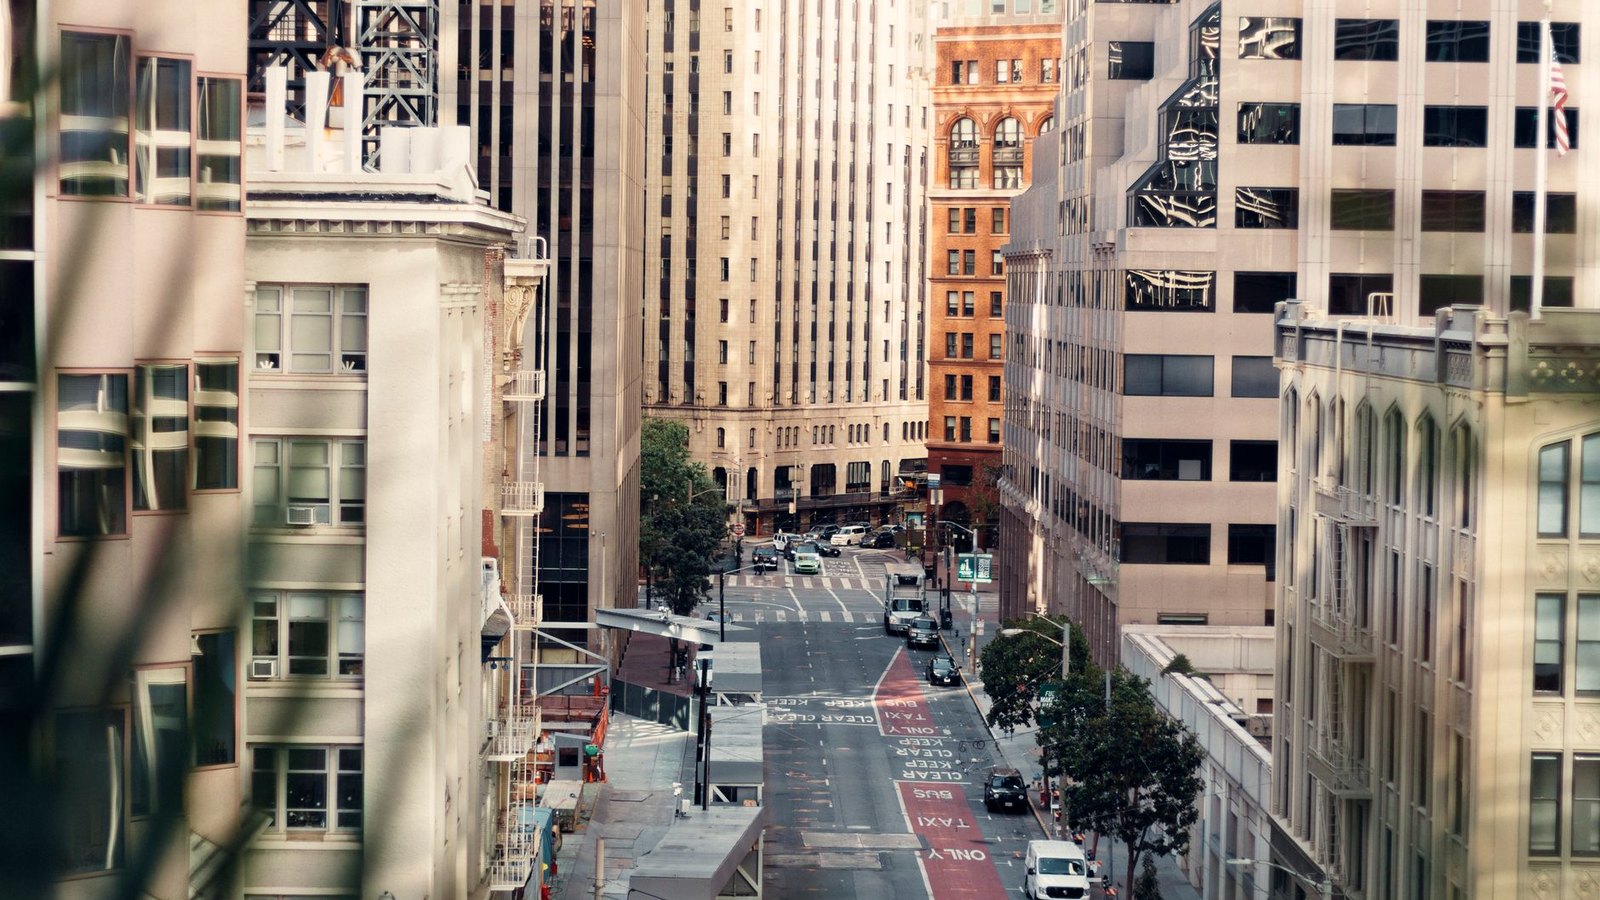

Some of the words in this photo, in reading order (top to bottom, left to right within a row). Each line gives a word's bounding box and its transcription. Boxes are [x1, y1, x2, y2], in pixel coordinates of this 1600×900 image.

[824, 700, 866, 708] KEEP
[885, 700, 918, 708] BUS
[821, 714, 874, 724] CLEAR
[885, 711, 927, 721] TAXI
[889, 726, 934, 735] ONLY
[899, 738, 944, 747] KEEP
[896, 748, 953, 758] CLEAR
[905, 760, 952, 769] KEEP
[903, 770, 962, 780] CLEAR
[913, 788, 953, 799] BUS
[917, 816, 970, 828] TAXI
[928, 848, 986, 861] ONLY
